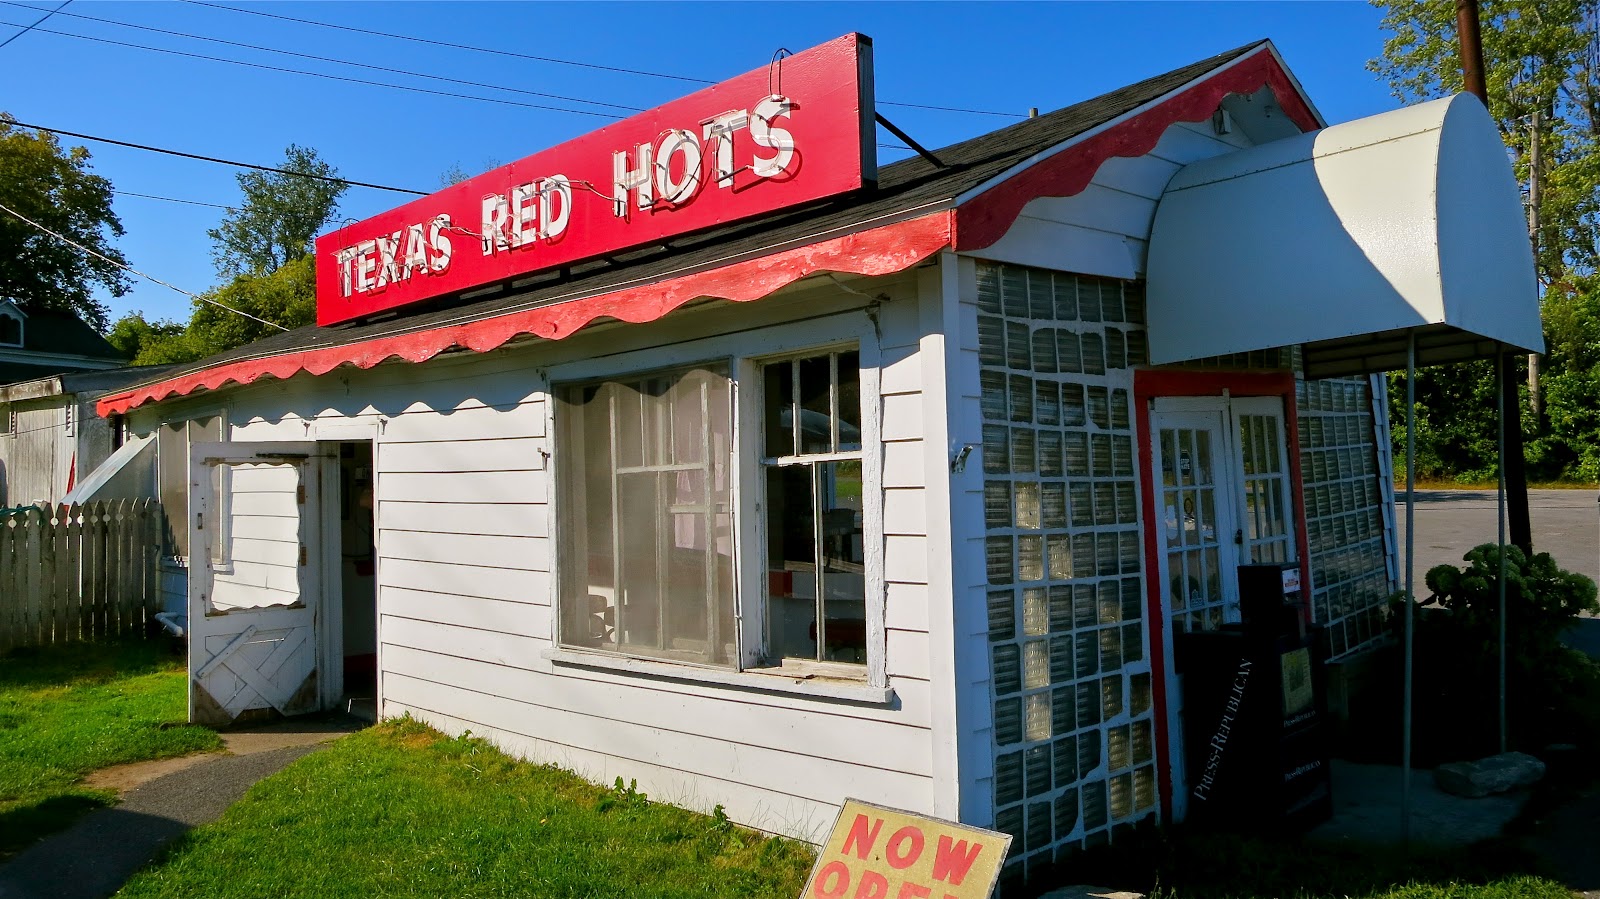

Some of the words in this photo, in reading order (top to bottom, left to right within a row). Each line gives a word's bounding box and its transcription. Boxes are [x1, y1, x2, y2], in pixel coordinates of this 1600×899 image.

[337, 213, 451, 298] TEXAS
[482, 174, 572, 256] RED
[612, 96, 795, 217] HOTS
[1193, 658, 1253, 801] PRESS-REPUBLICAN
[813, 861, 959, 899] OP
[841, 814, 983, 886] NOW
